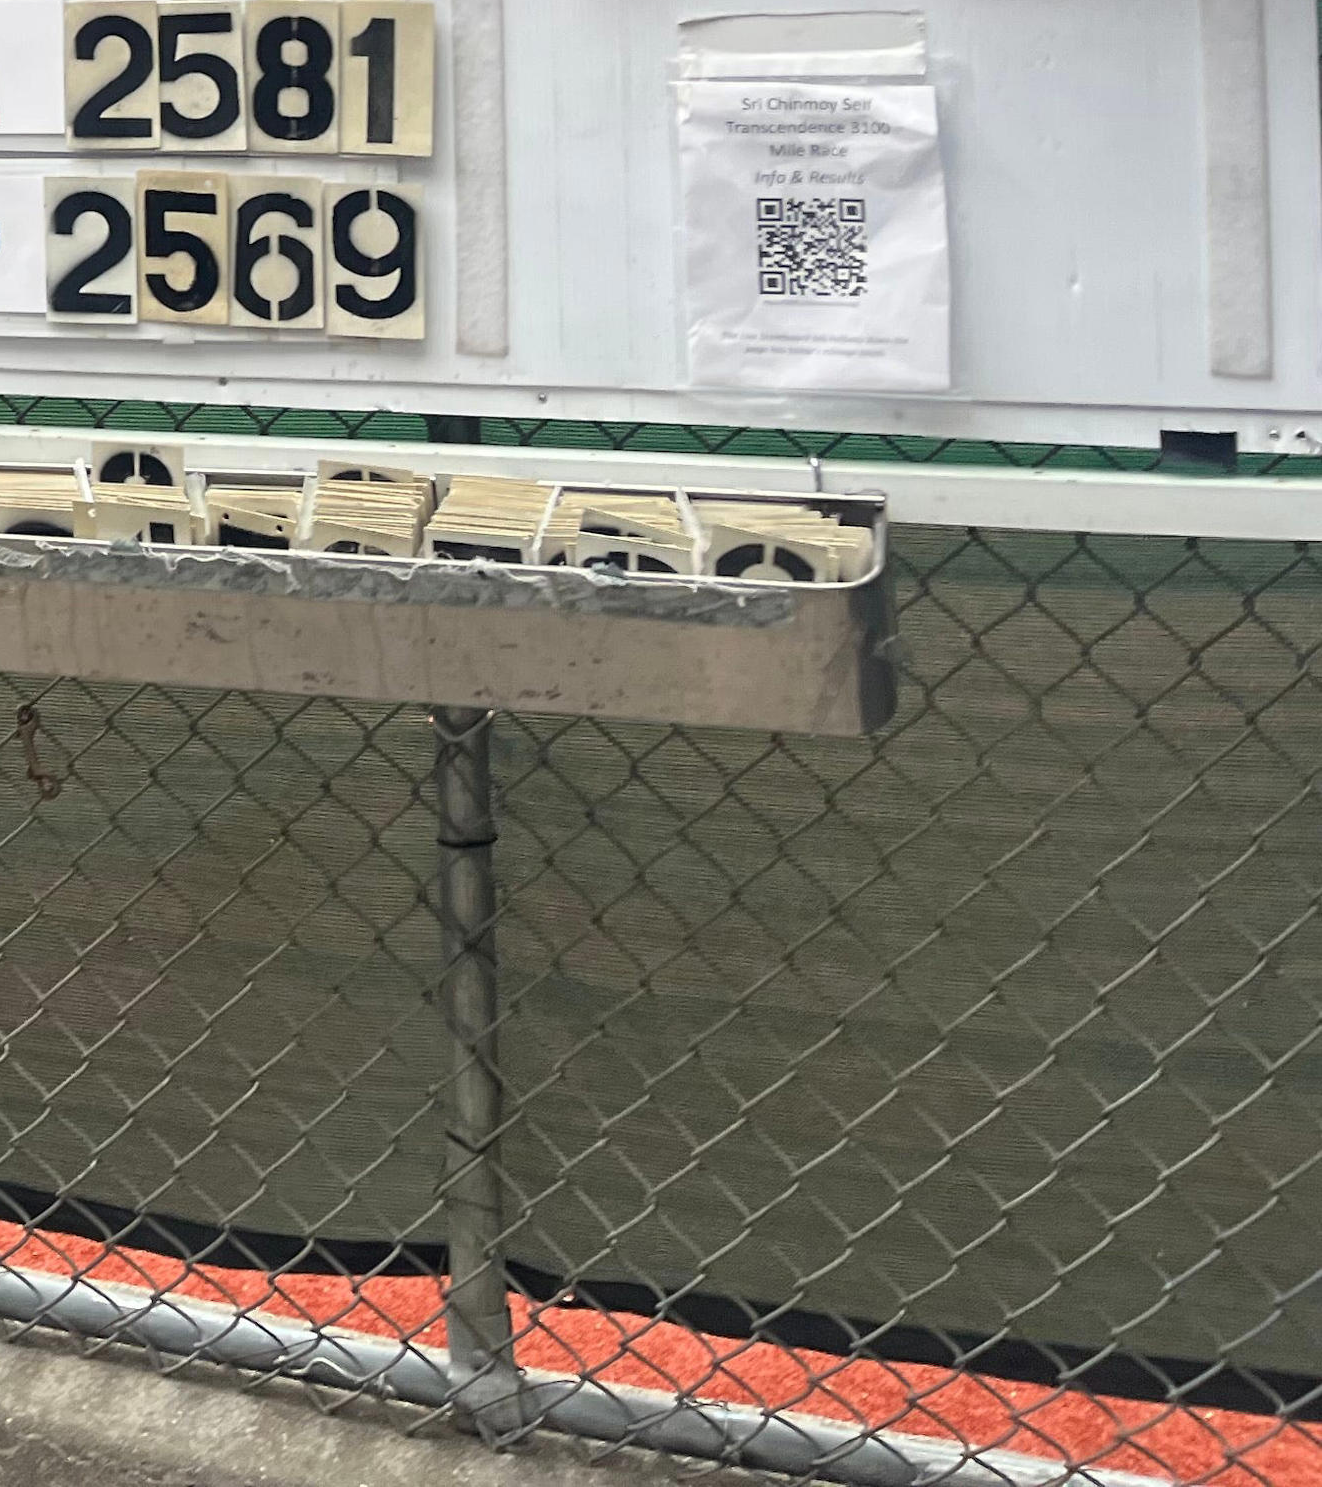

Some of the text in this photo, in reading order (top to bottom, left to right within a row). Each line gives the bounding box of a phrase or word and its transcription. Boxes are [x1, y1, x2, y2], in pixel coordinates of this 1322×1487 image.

[73, 11, 396, 145] 2581
[767, 97, 837, 113] Chinmoy
[726, 121, 845, 134] Transcendence
[769, 144, 848, 157] Mile Race
[754, 169, 865, 187] Info & Results
[51, 188, 417, 322] 2569
